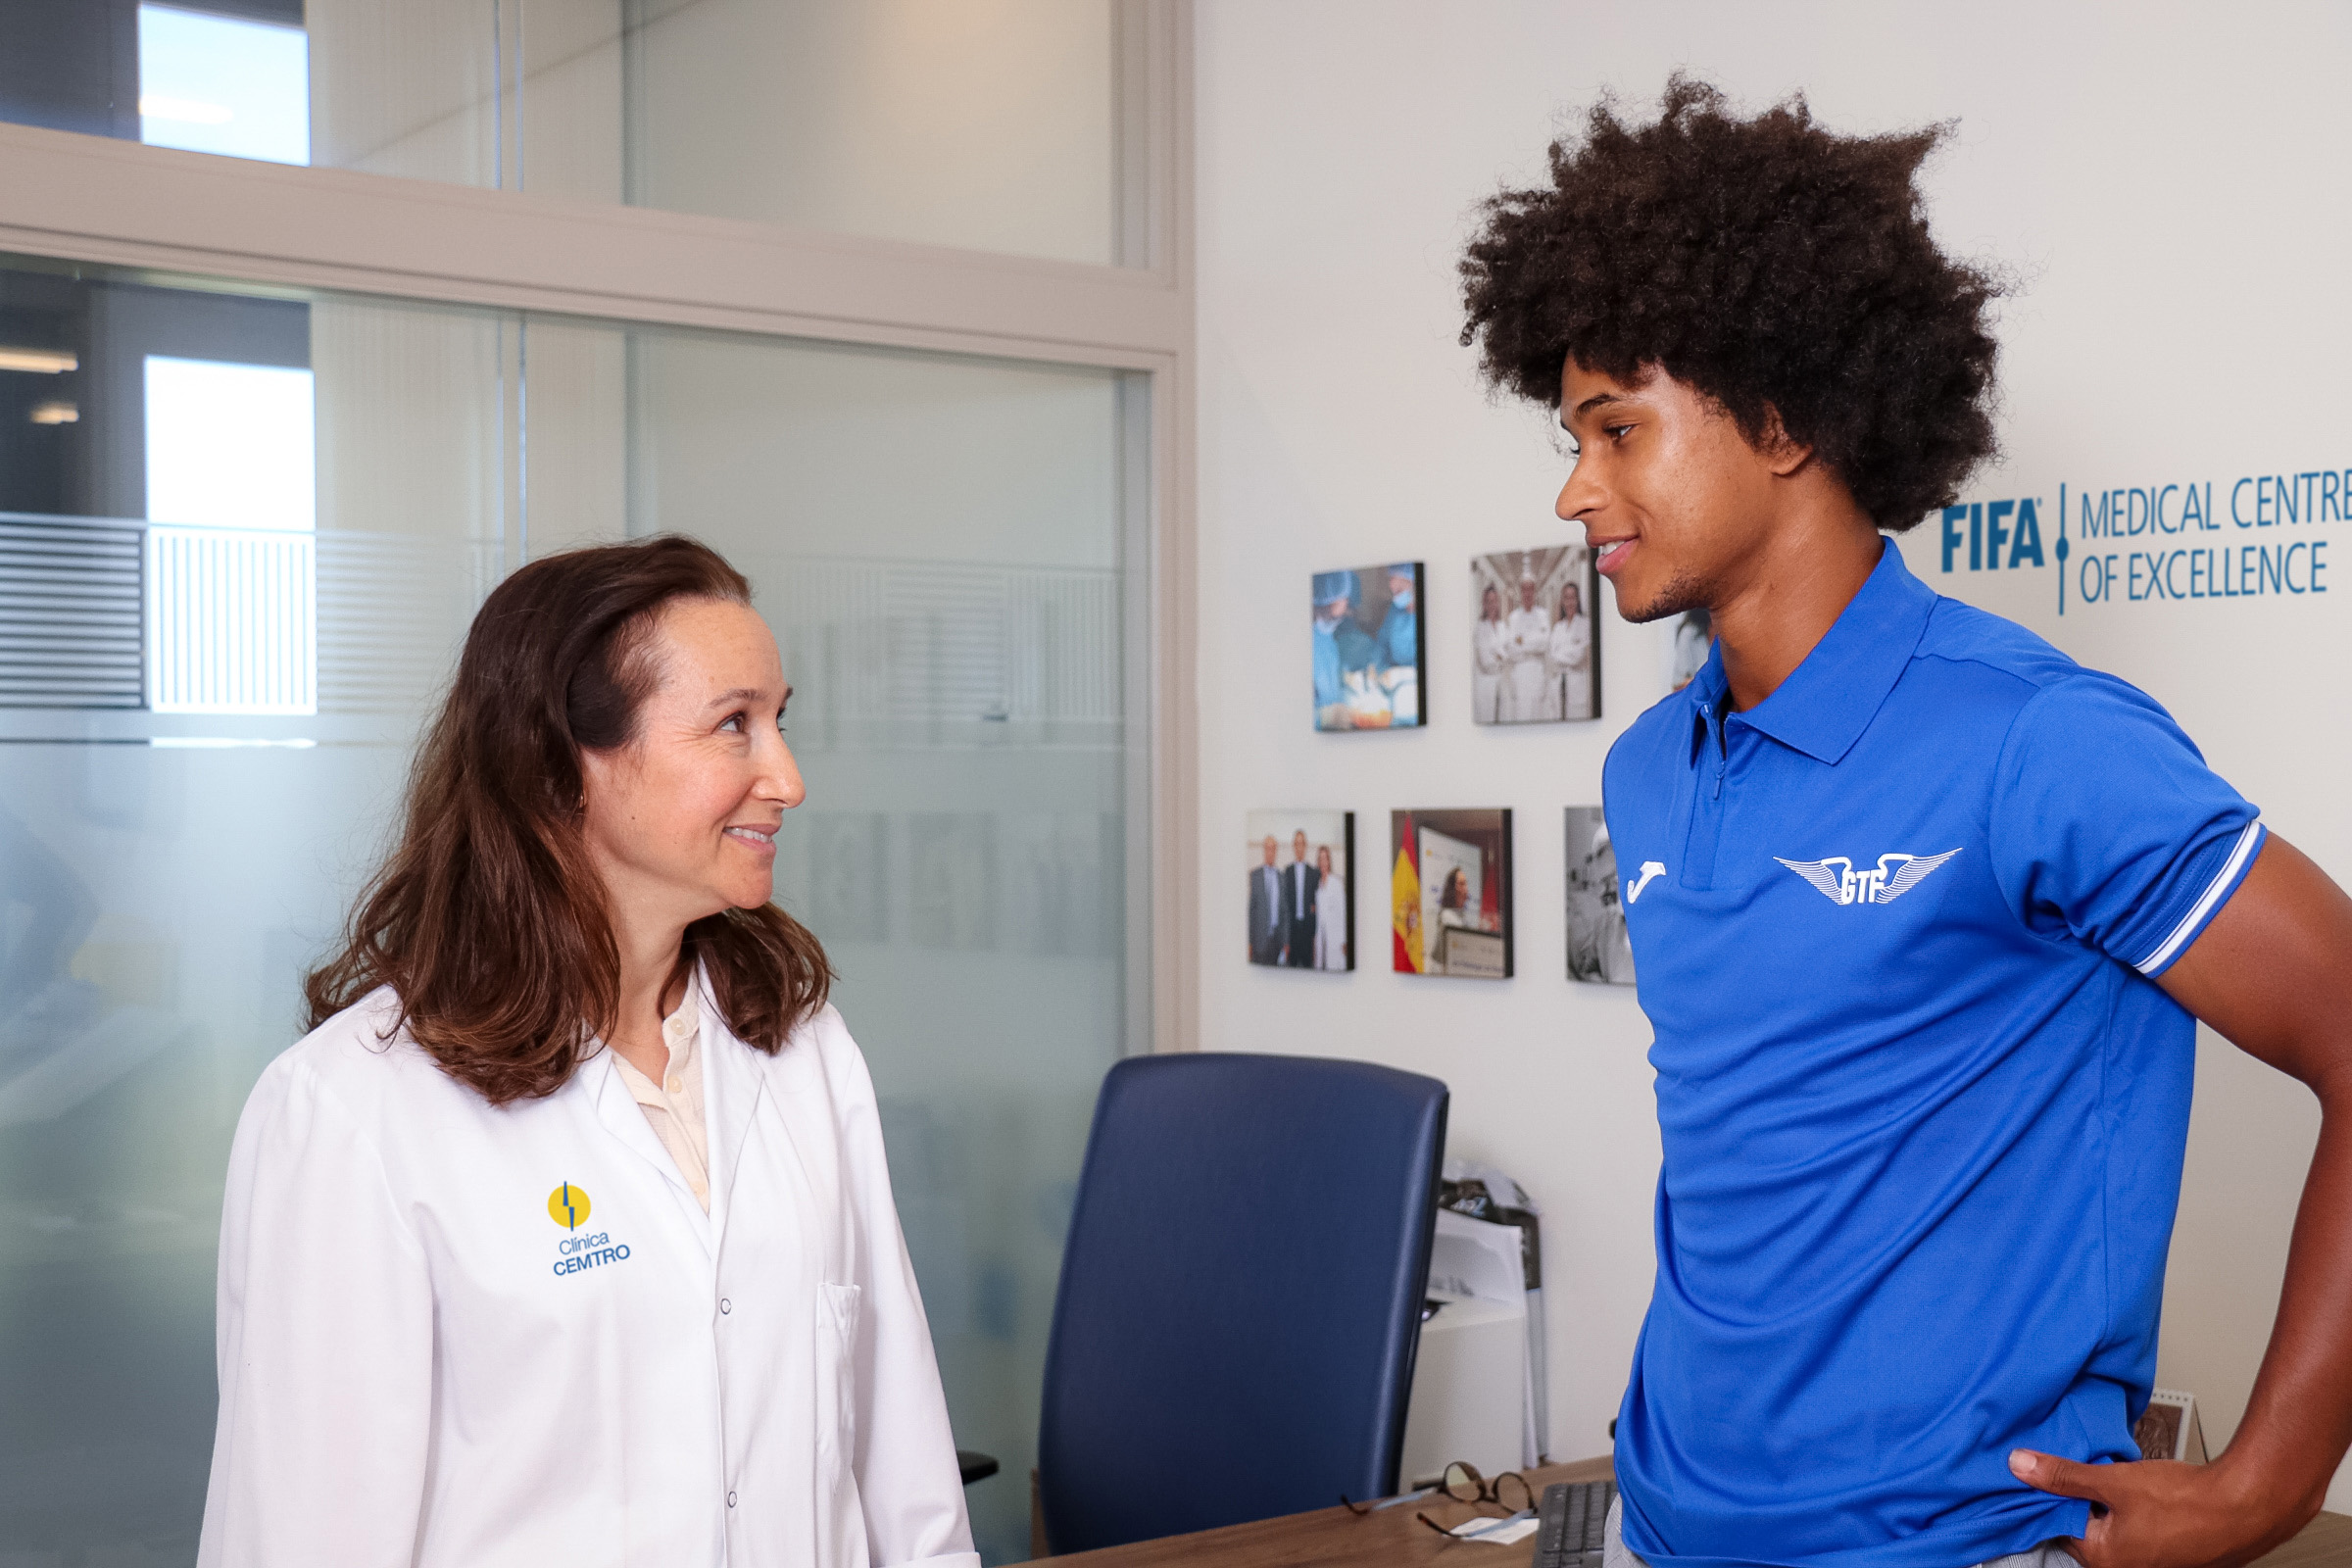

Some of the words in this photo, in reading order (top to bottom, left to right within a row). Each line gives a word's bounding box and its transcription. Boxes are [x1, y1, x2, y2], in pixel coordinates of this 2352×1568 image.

[2082, 481, 2221, 539] MEDICAL
[2231, 468, 2352, 528] CENTRE
[1941, 497, 2045, 573] FIFA
[2080, 555, 2118, 603] OF
[2128, 541, 2328, 601] EXCELLENCE
[553, 1244, 631, 1276] CEMTRO
[559, 1232, 610, 1255] Clínica
